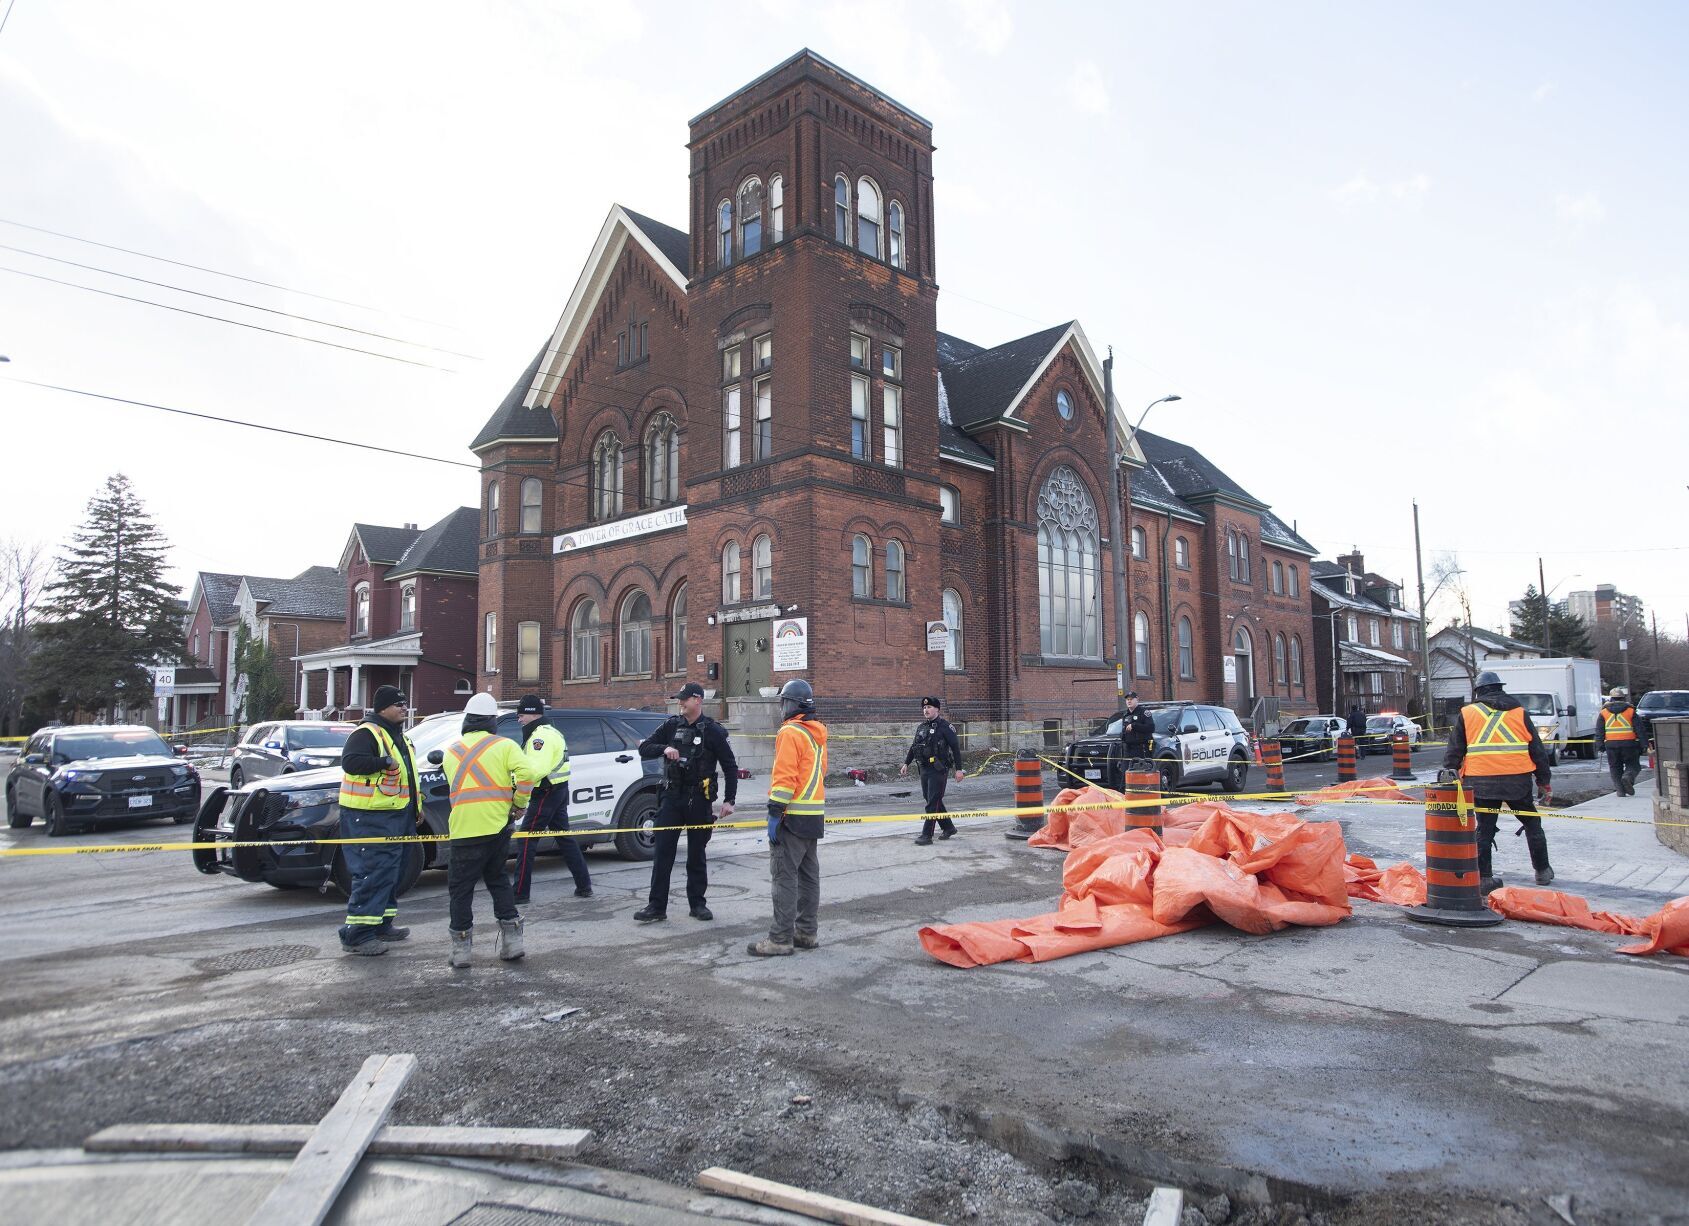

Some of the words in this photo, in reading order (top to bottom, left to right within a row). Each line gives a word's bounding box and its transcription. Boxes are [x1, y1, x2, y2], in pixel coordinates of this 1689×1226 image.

[579, 530, 607, 545] TOWER
[608, 525, 620, 538] OF
[622, 517, 653, 535] GRACE
[656, 509, 686, 527] CATH
[158, 675, 172, 684] 40
[1192, 747, 1228, 760] POLICE
